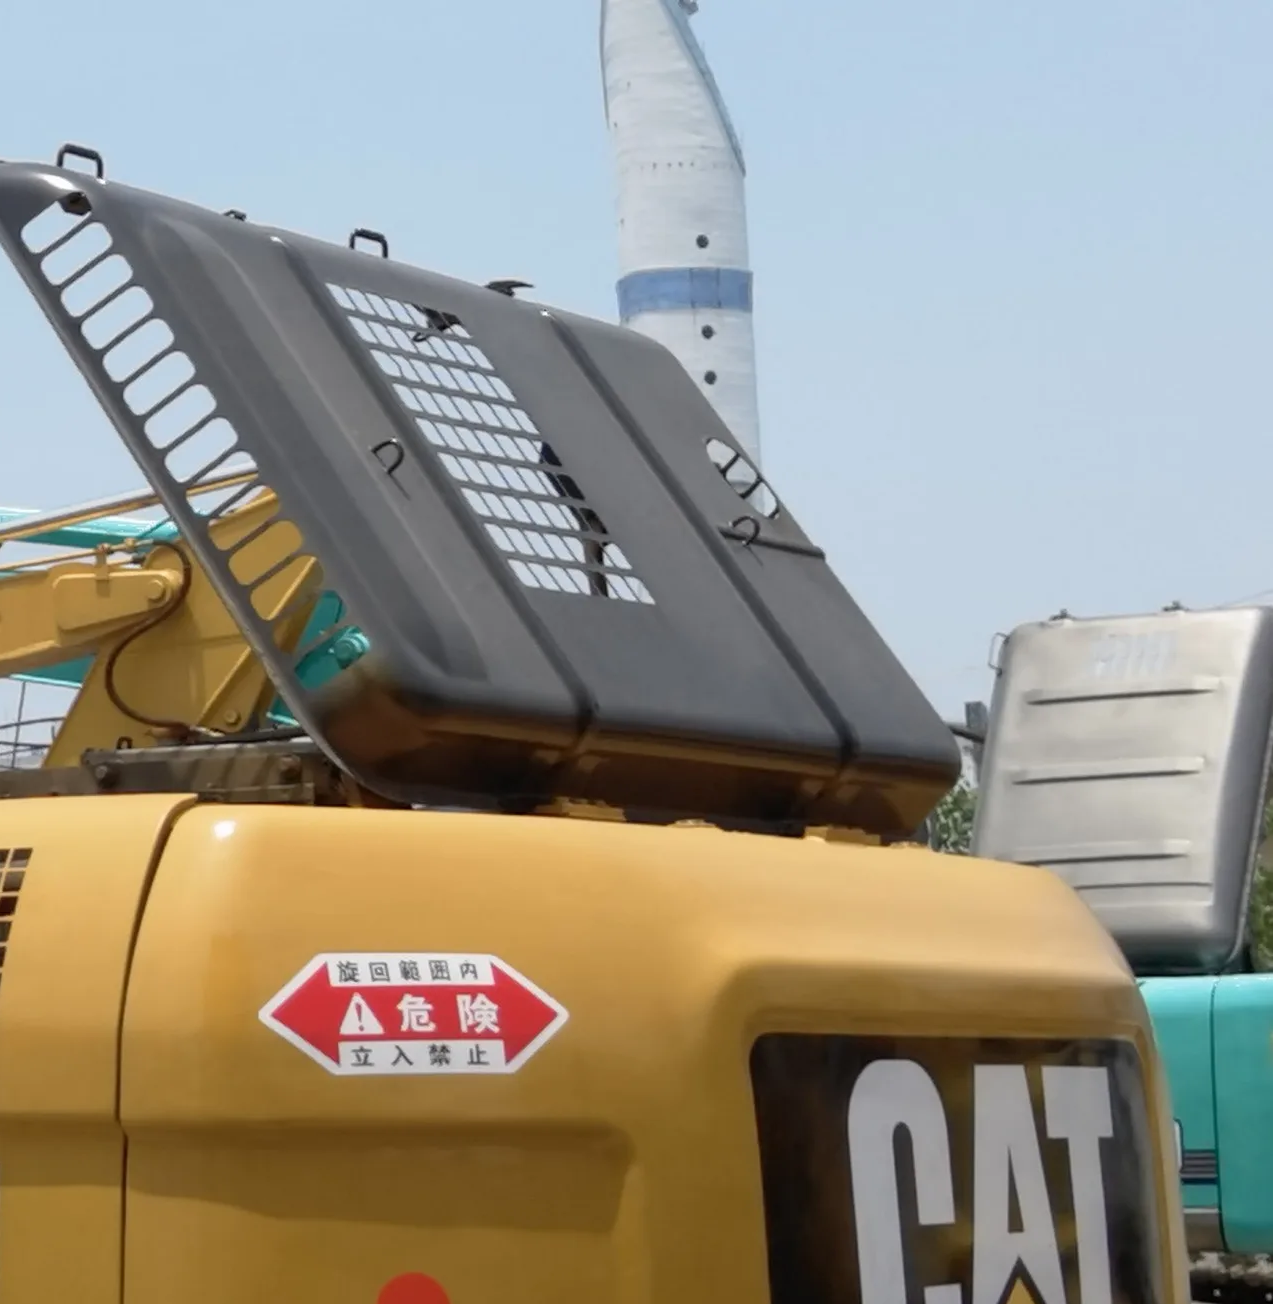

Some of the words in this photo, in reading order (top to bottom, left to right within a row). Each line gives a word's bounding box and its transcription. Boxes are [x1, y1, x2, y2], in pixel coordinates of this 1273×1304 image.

[336, 959, 480, 983] 旋回範囲内
[396, 993, 502, 1034] 危険
[350, 1043, 491, 1068] 立入禁止
